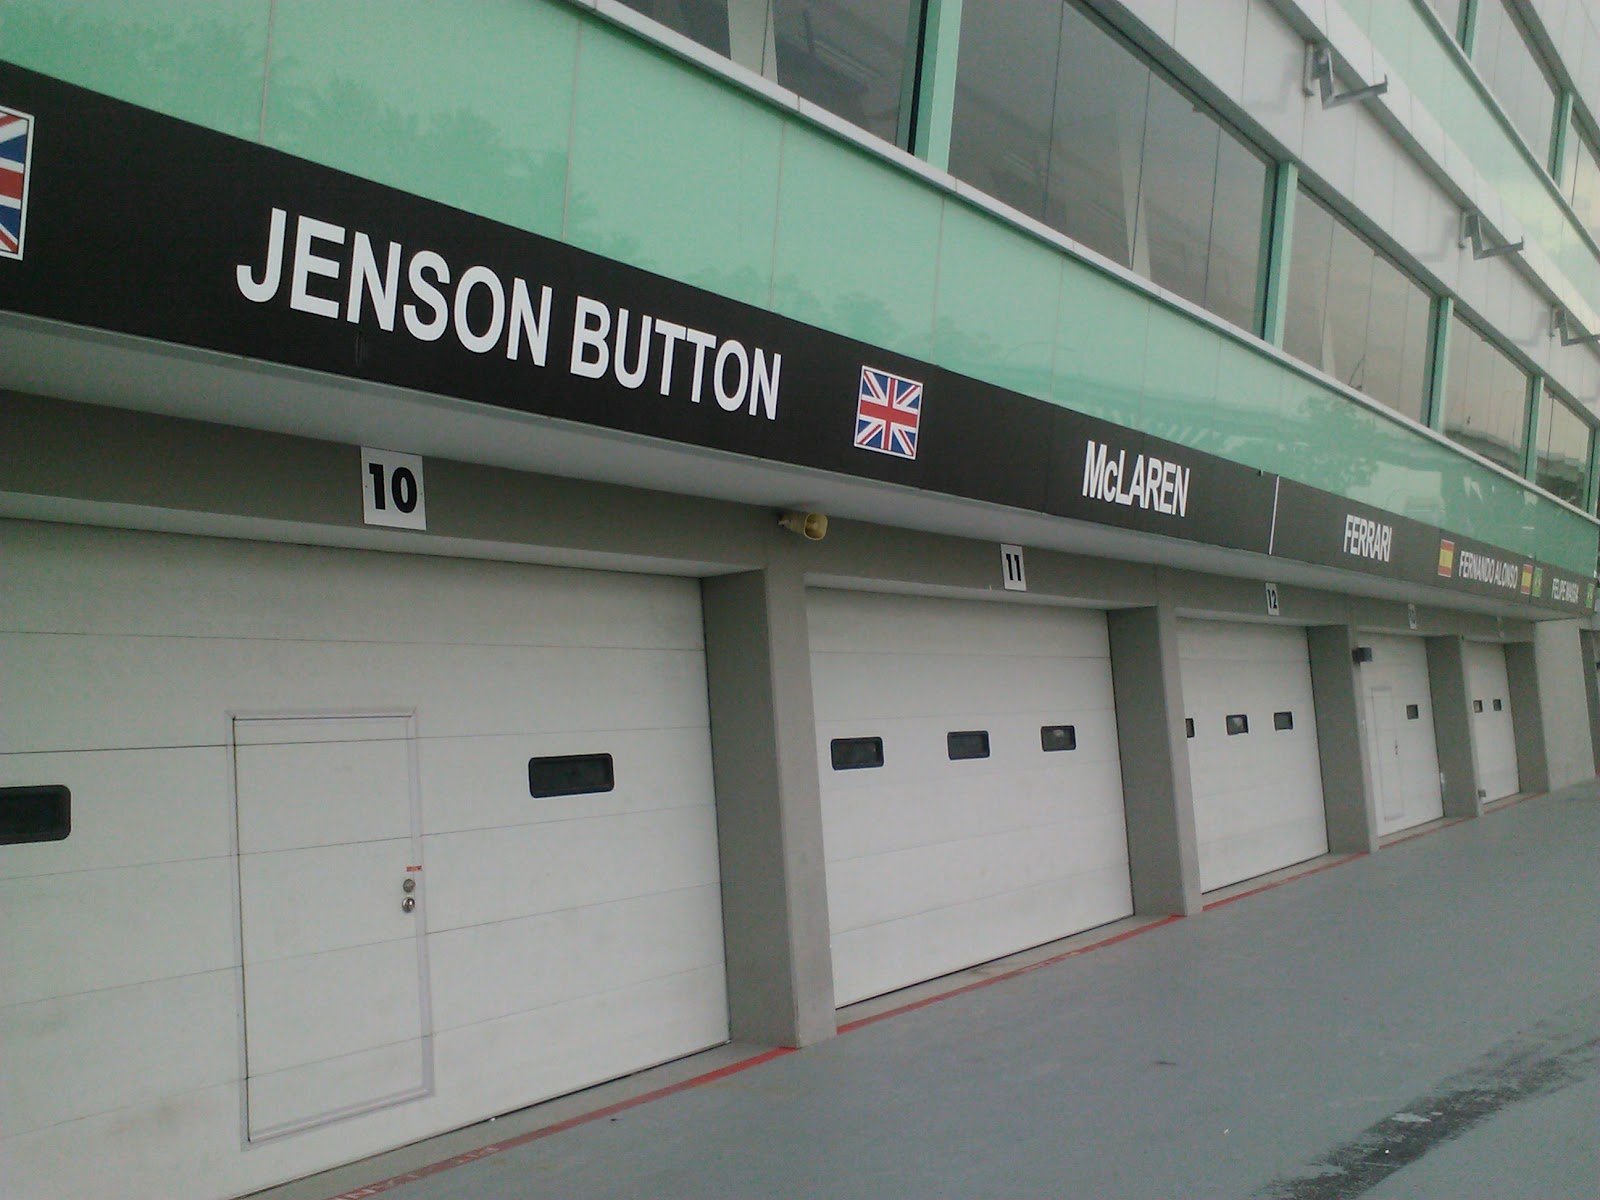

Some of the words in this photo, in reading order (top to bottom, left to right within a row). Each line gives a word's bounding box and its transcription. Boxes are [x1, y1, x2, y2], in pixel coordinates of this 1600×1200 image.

[237, 207, 553, 367] JENSON
[570, 295, 782, 421] BUTTON
[368, 462, 418, 514] 10
[1082, 440, 1191, 518] McLAREN
[1343, 513, 1393, 563] FERRARI
[1005, 553, 1022, 582] 11
[1458, 550, 1495, 584] FERNANDO
[1266, 588, 1278, 609] 12
